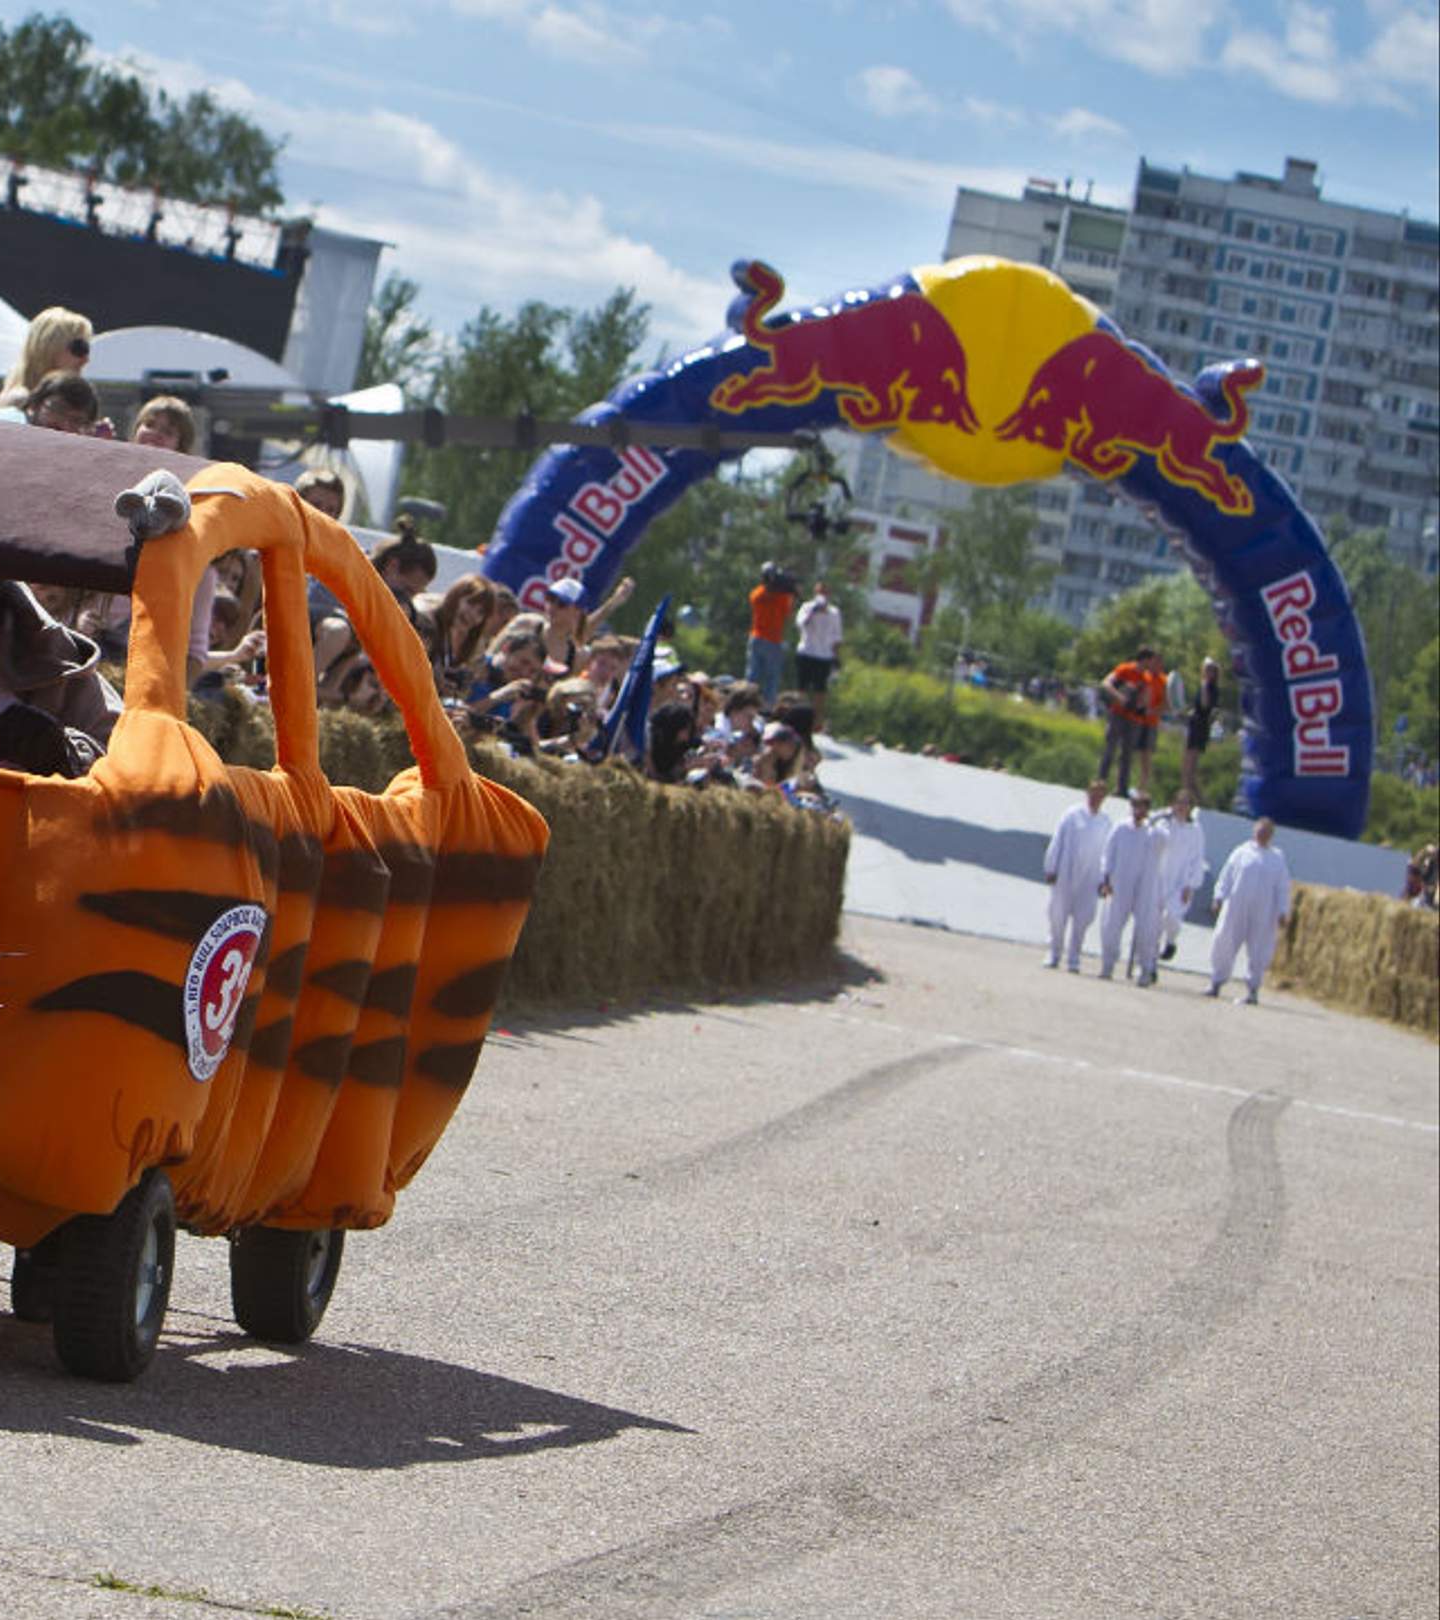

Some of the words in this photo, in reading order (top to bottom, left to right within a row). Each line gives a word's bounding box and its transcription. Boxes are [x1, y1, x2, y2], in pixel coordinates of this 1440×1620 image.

[569, 445, 669, 536] Bull
[1261, 571, 1338, 679] Red
[1290, 680, 1349, 776] Bull
